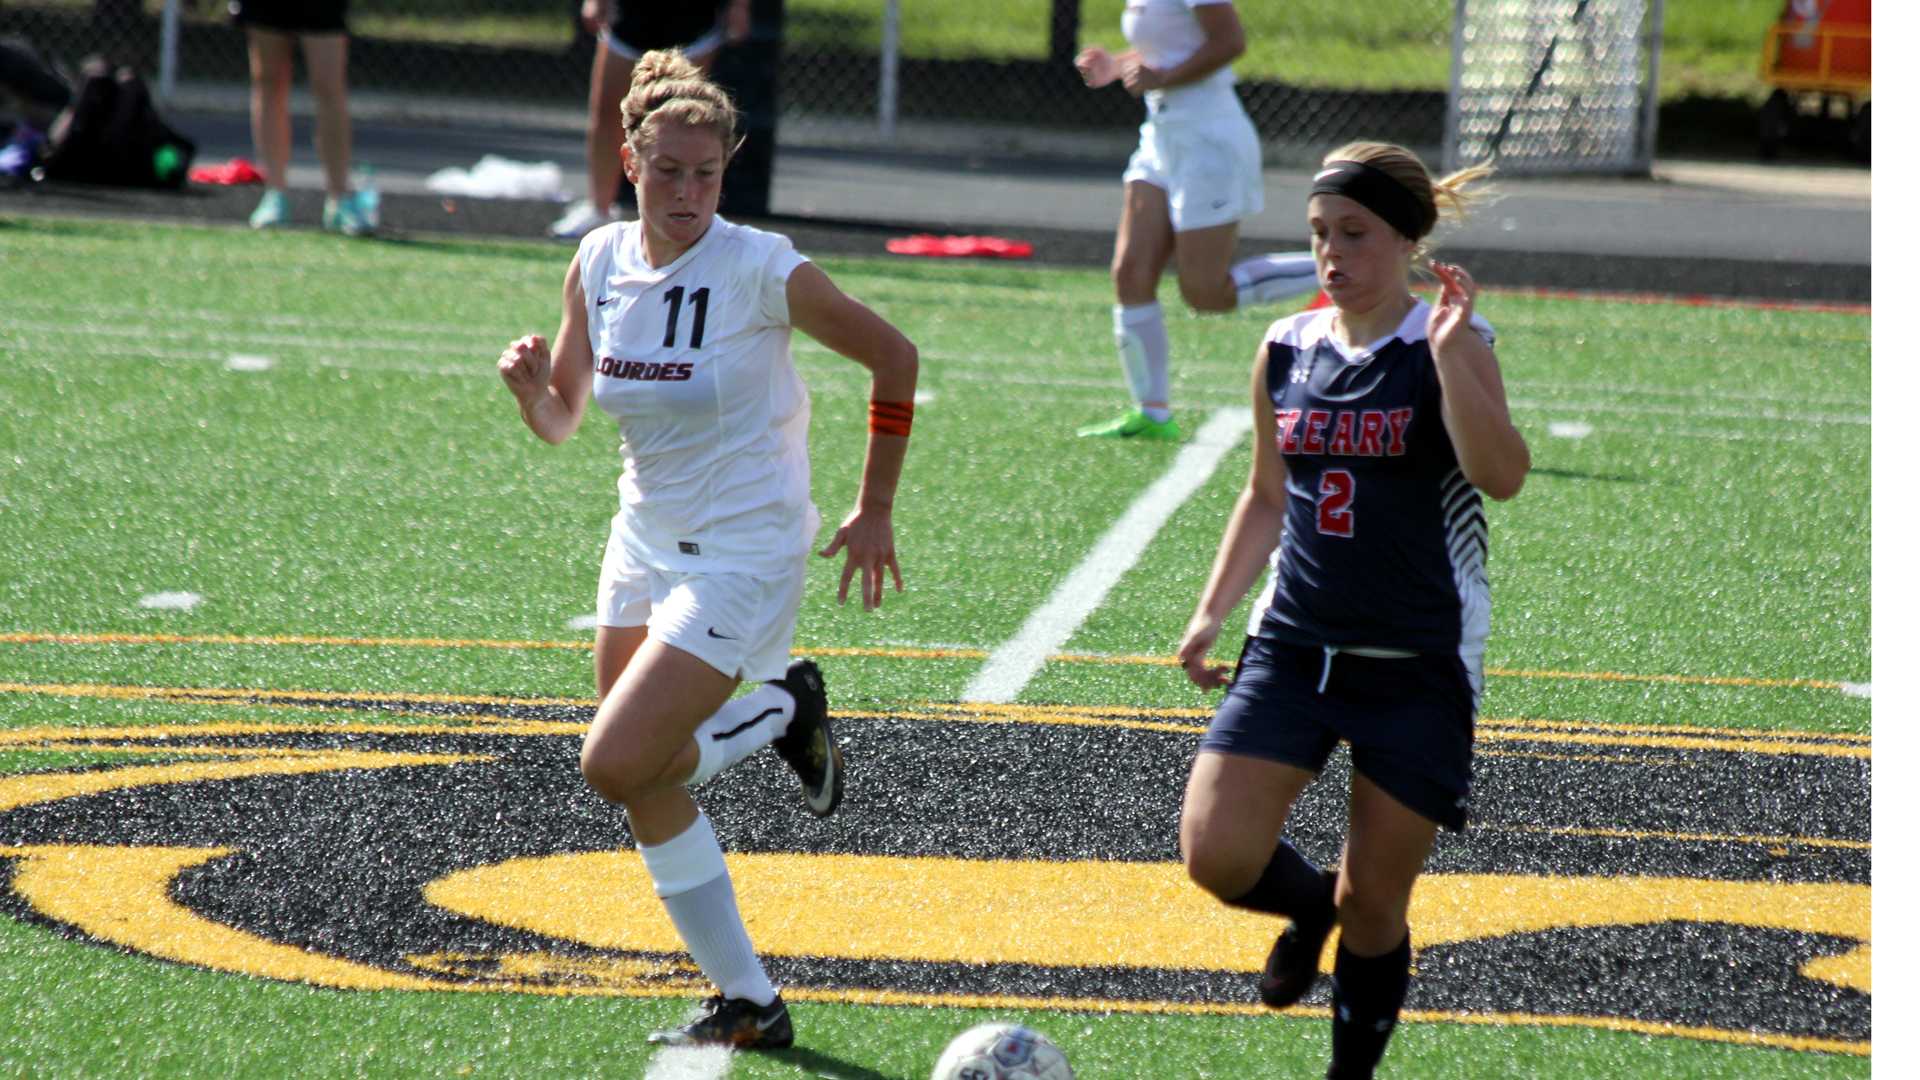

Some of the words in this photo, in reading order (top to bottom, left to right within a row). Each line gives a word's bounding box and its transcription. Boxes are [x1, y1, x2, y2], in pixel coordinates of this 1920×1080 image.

[662, 285, 711, 349] 11
[595, 355, 694, 381] LOURDES
[1316, 468, 1356, 538] 2
